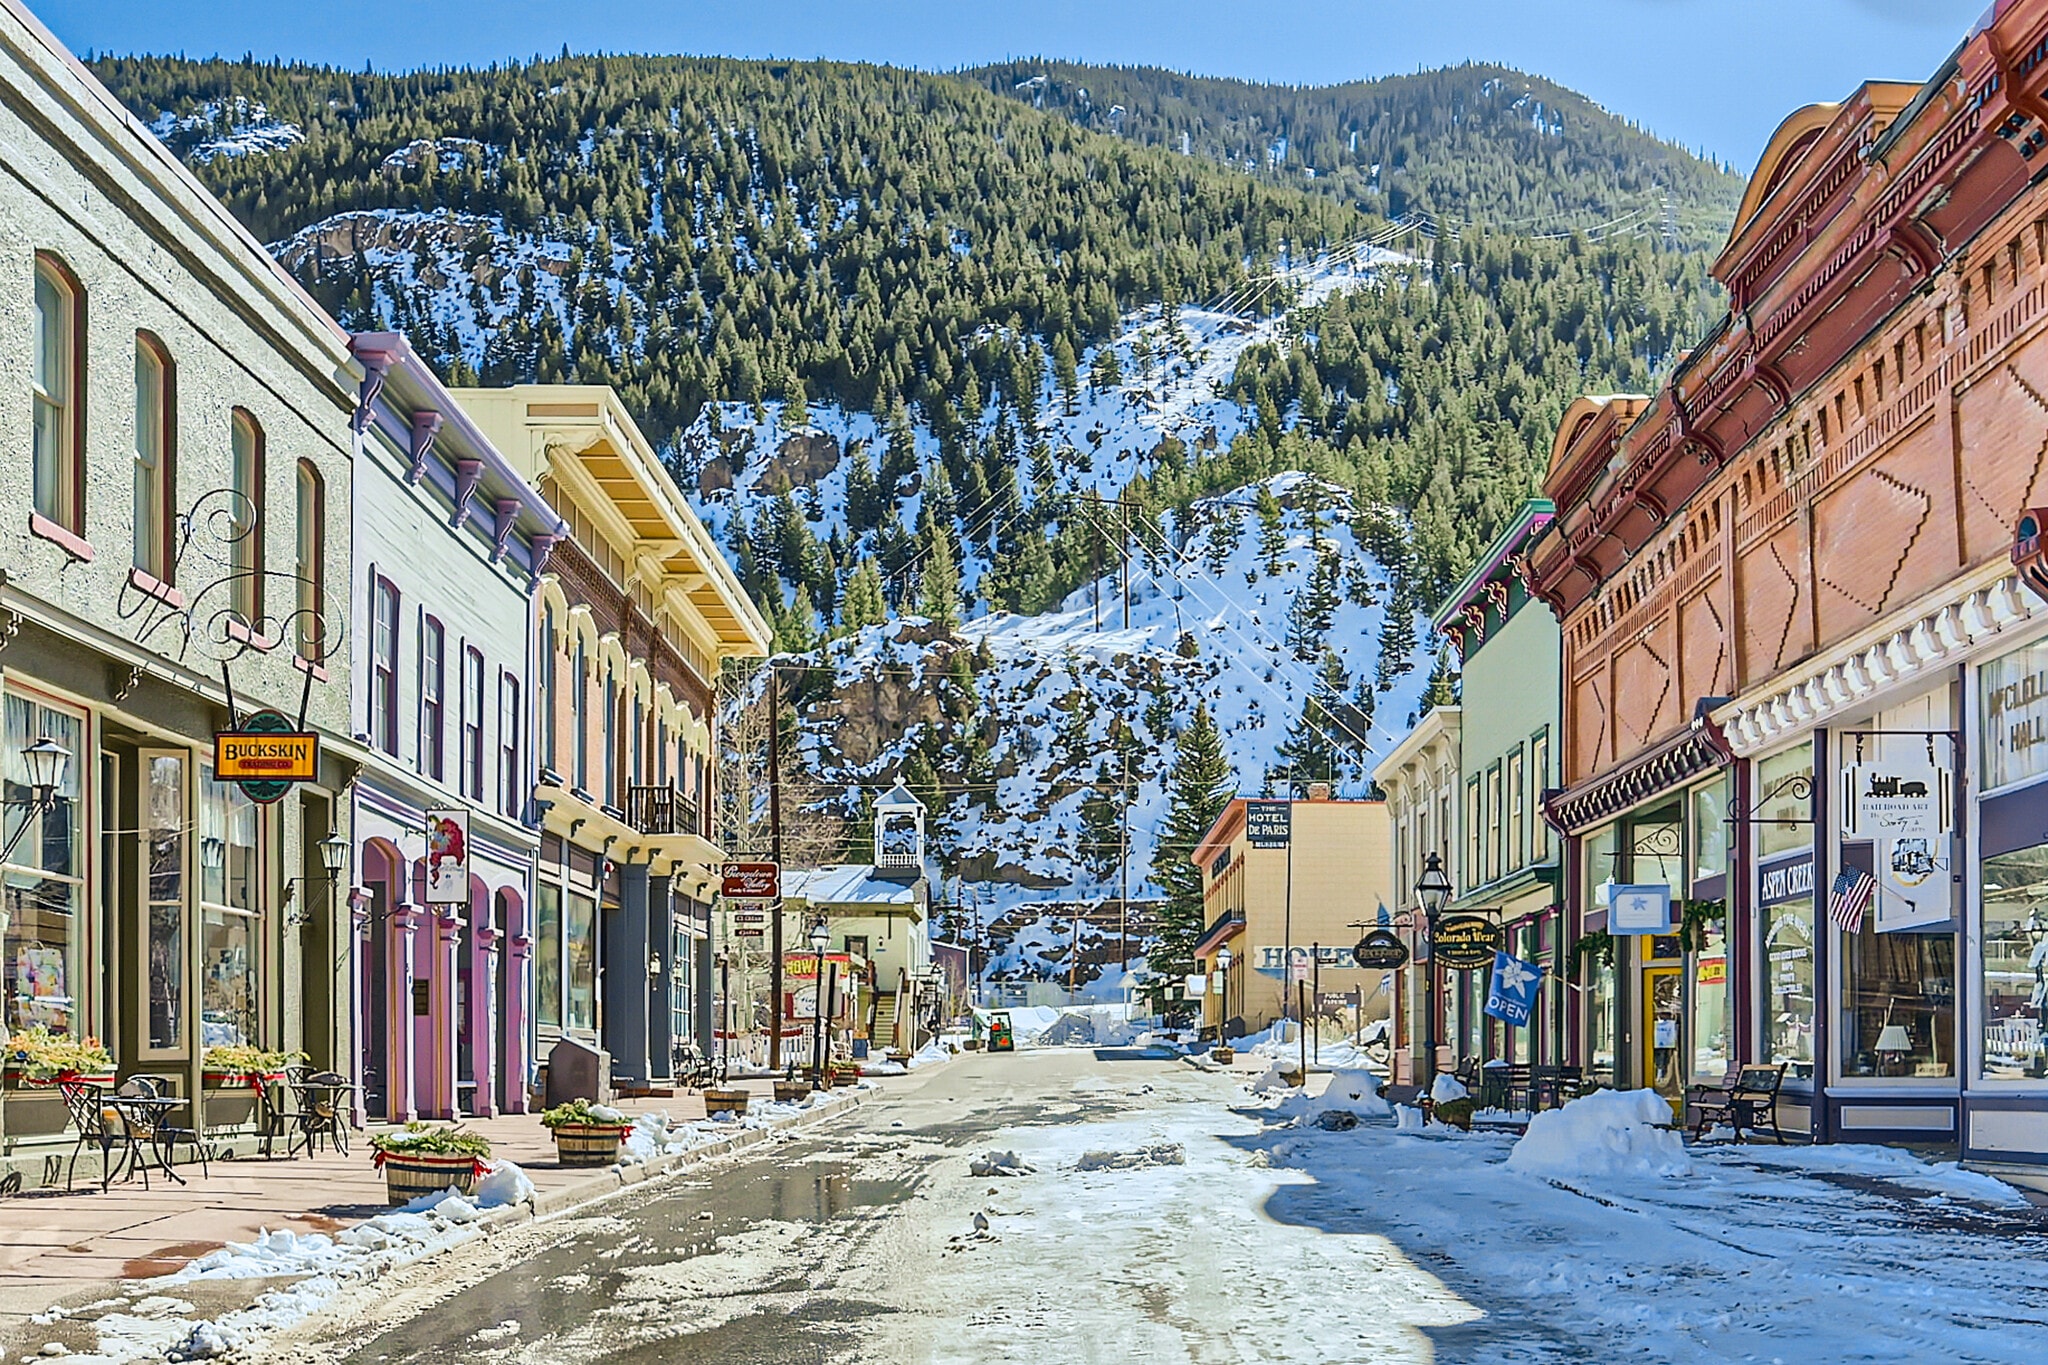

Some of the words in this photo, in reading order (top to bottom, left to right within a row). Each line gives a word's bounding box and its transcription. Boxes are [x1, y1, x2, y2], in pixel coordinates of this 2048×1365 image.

[225, 744, 307, 760] BUCKSKIN
[1248, 814, 1288, 823] HOTEL
[1262, 825, 1289, 835] PARIS
[1762, 868, 1787, 901] ASPEN
[1787, 861, 1814, 895] CREEK
[1434, 930, 1472, 943] Colorado
[1472, 928, 1497, 942] Wear
[1262, 947, 1362, 967] HOTE
[1488, 996, 1529, 1021] OPEN
